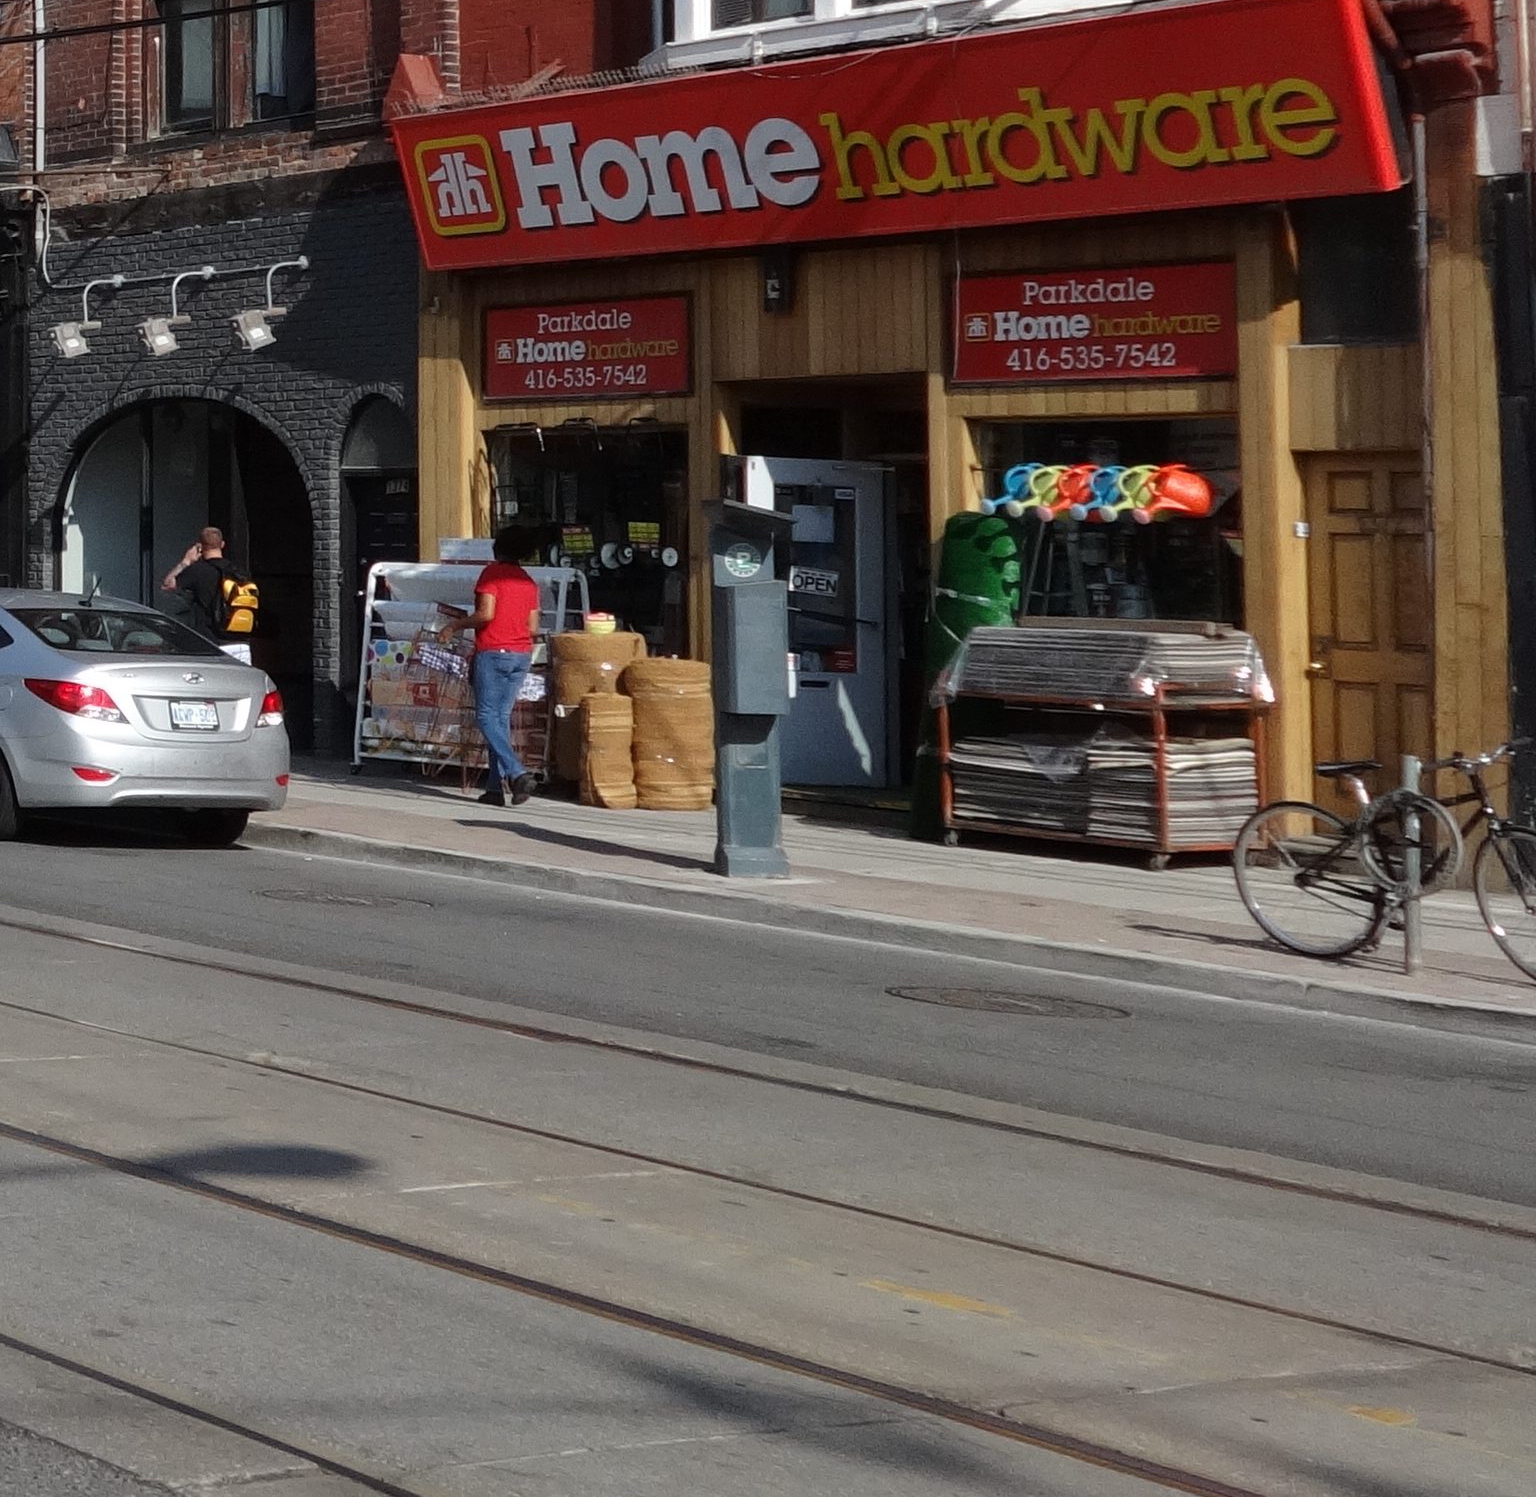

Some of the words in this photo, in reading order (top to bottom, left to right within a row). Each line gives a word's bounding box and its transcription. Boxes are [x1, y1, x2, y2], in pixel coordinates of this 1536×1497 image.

[499, 117, 821, 230] Home
[819, 78, 1336, 199] hardware
[1022, 277, 1155, 305] Parkdale
[537, 309, 632, 334] Parkdale
[993, 310, 1091, 342] Home
[1091, 310, 1222, 338] hardware
[516, 337, 586, 365] Home
[586, 337, 678, 361] hardware
[1006, 342, 1177, 372] 416-535-7542
[524, 364, 647, 390] 416-535-7542
[792, 574, 837, 592] OPEN
